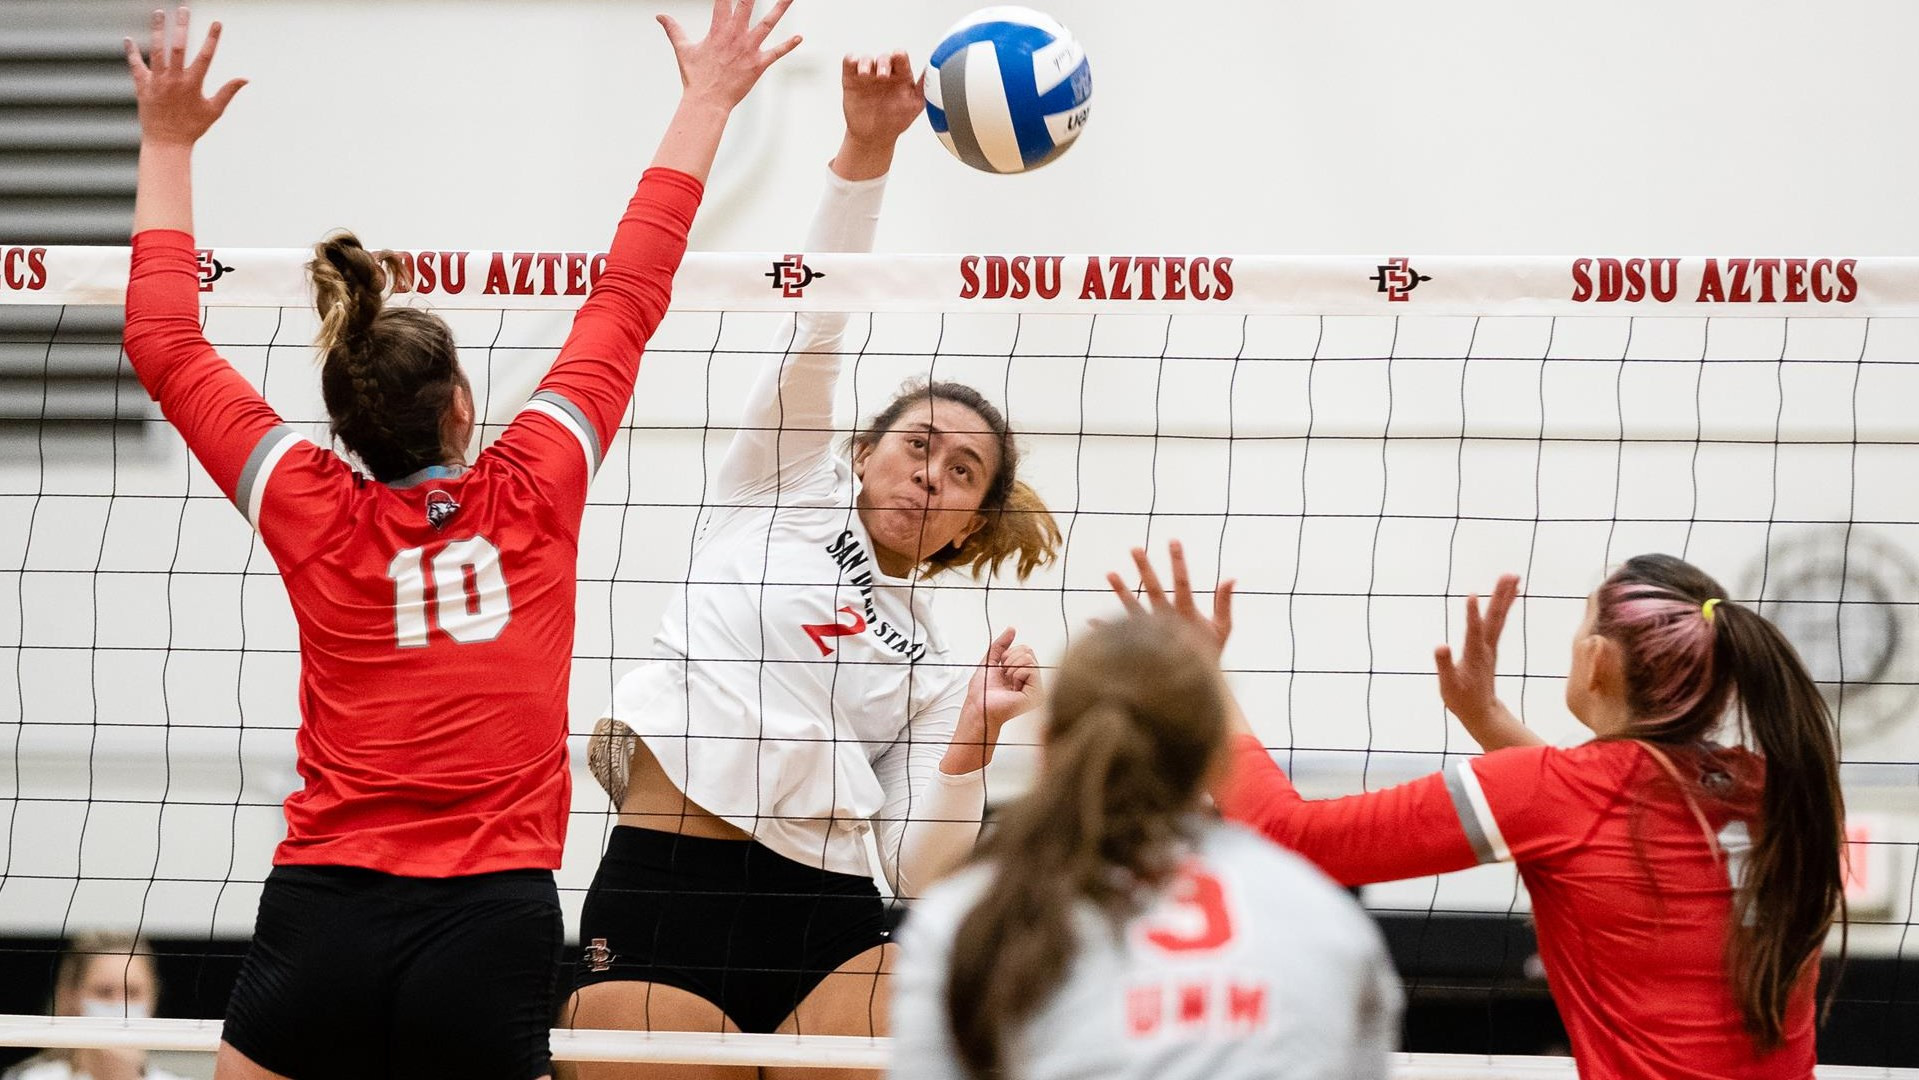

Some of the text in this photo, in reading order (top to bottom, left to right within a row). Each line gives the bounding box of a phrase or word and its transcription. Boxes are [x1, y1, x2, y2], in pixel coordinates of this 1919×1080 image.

[0, 247, 47, 290] CS
[371, 251, 470, 295] DSU
[959, 255, 1234, 301] SDSU AZTECS
[1571, 258, 1858, 303] SDSU AZTECS
[826, 530, 869, 574] SAN
[387, 533, 512, 648] 10
[801, 606, 866, 657] 2
